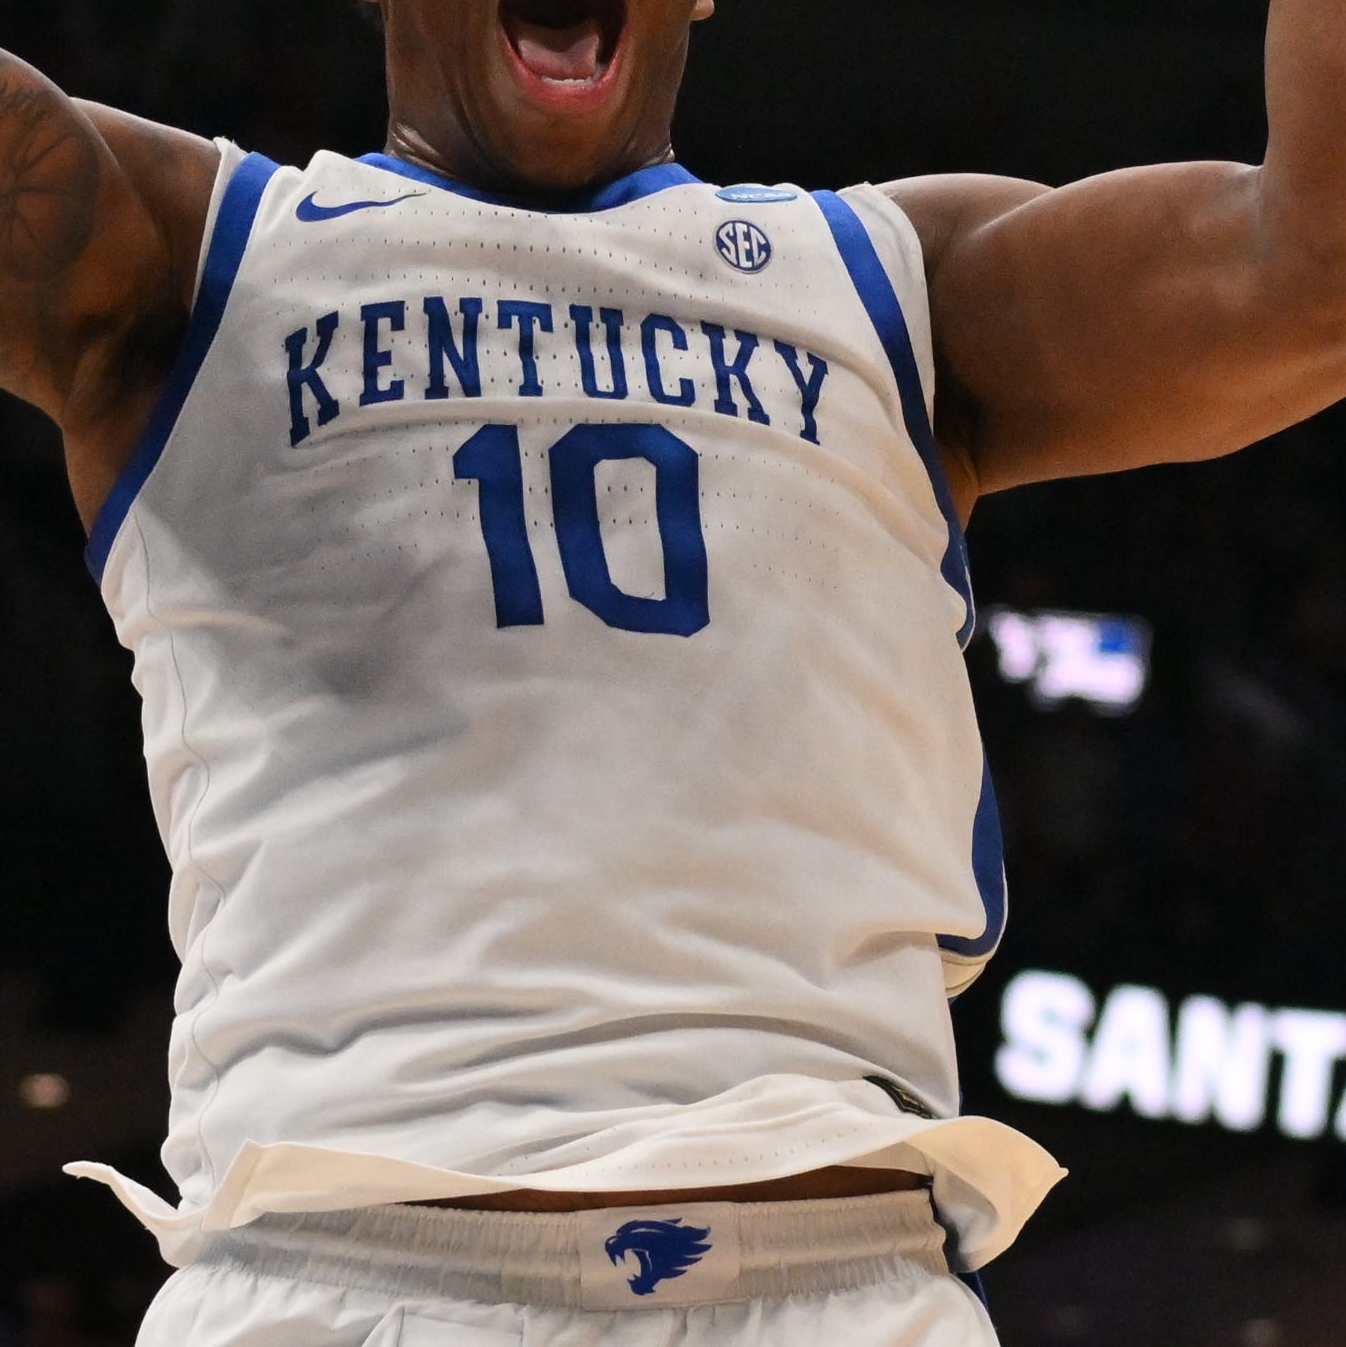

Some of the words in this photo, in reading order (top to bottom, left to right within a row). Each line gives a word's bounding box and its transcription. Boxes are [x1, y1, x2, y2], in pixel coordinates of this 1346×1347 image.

[718, 222, 767, 268] SEC
[282, 296, 829, 448] KENTUCKY
[452, 423, 711, 637] 10
